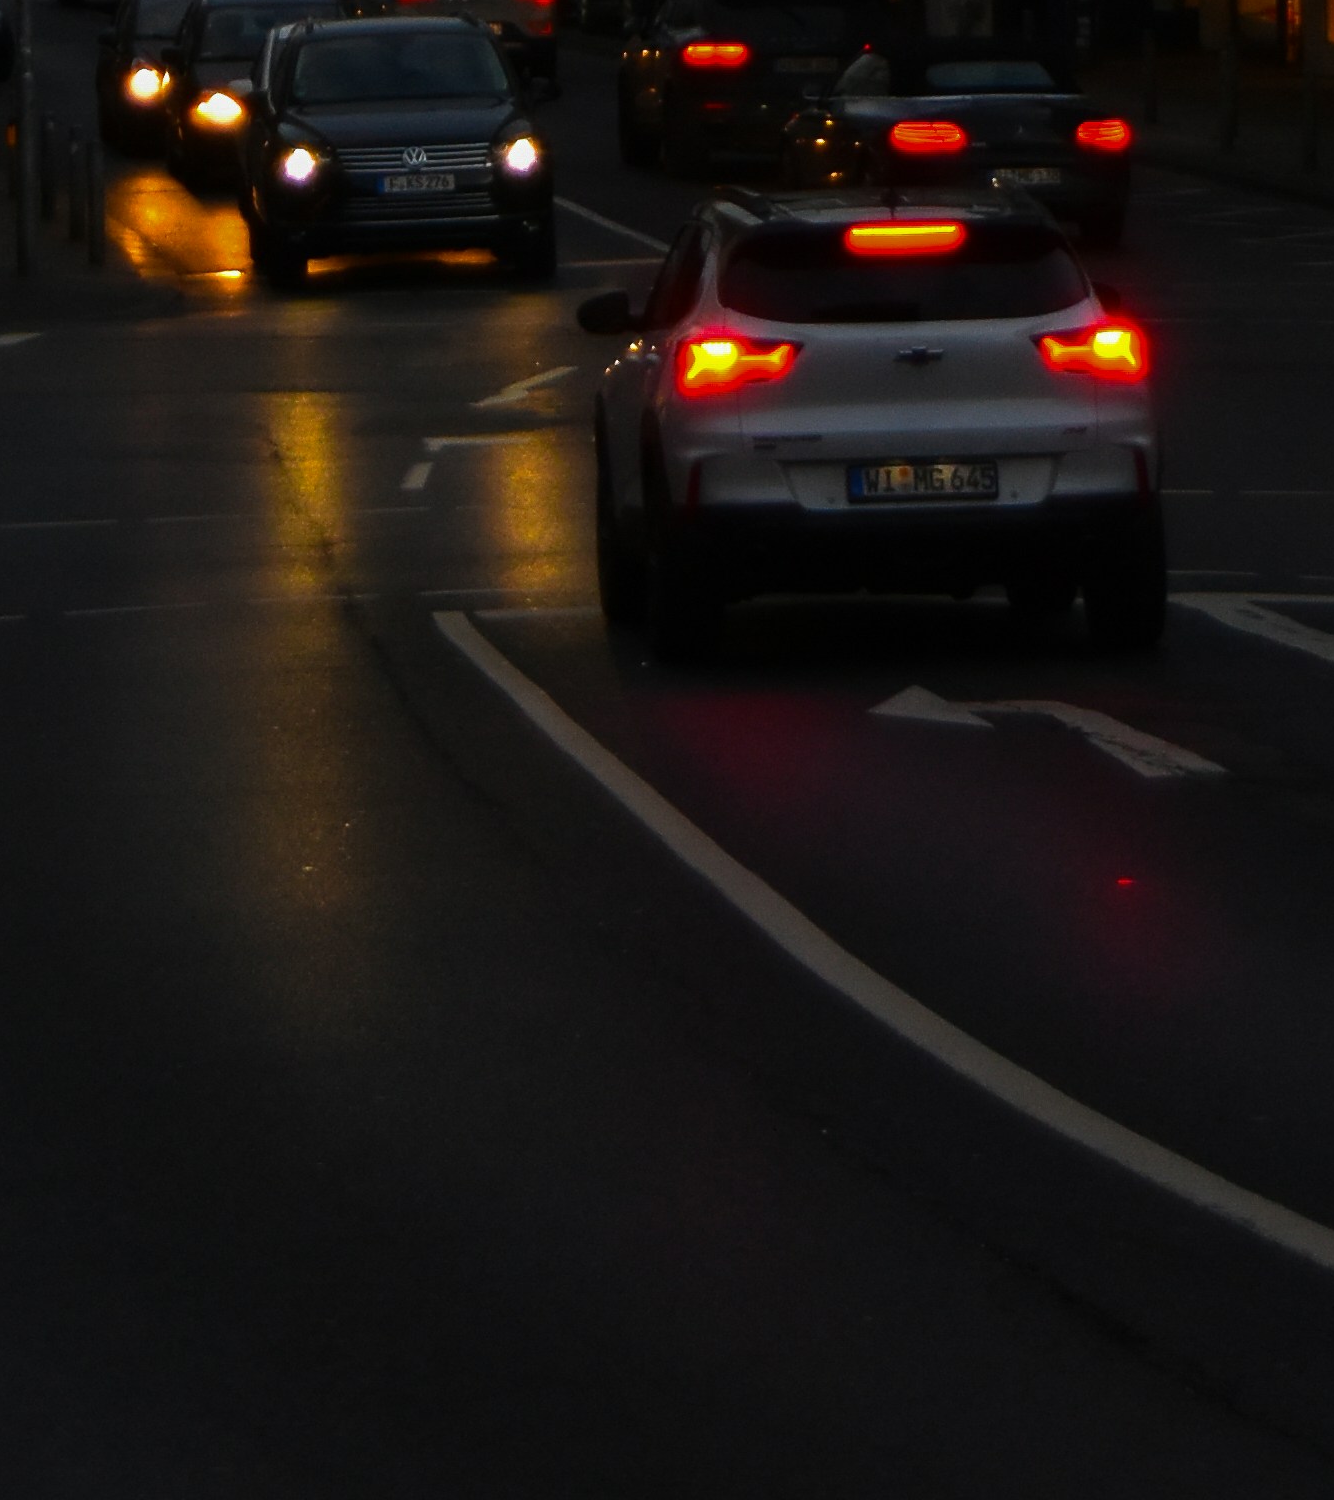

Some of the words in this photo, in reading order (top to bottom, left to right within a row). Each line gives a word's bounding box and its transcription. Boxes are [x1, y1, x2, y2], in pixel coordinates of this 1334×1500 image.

[865, 466, 895, 493] WI
[916, 467, 946, 492] MG
[949, 466, 997, 492] 645
